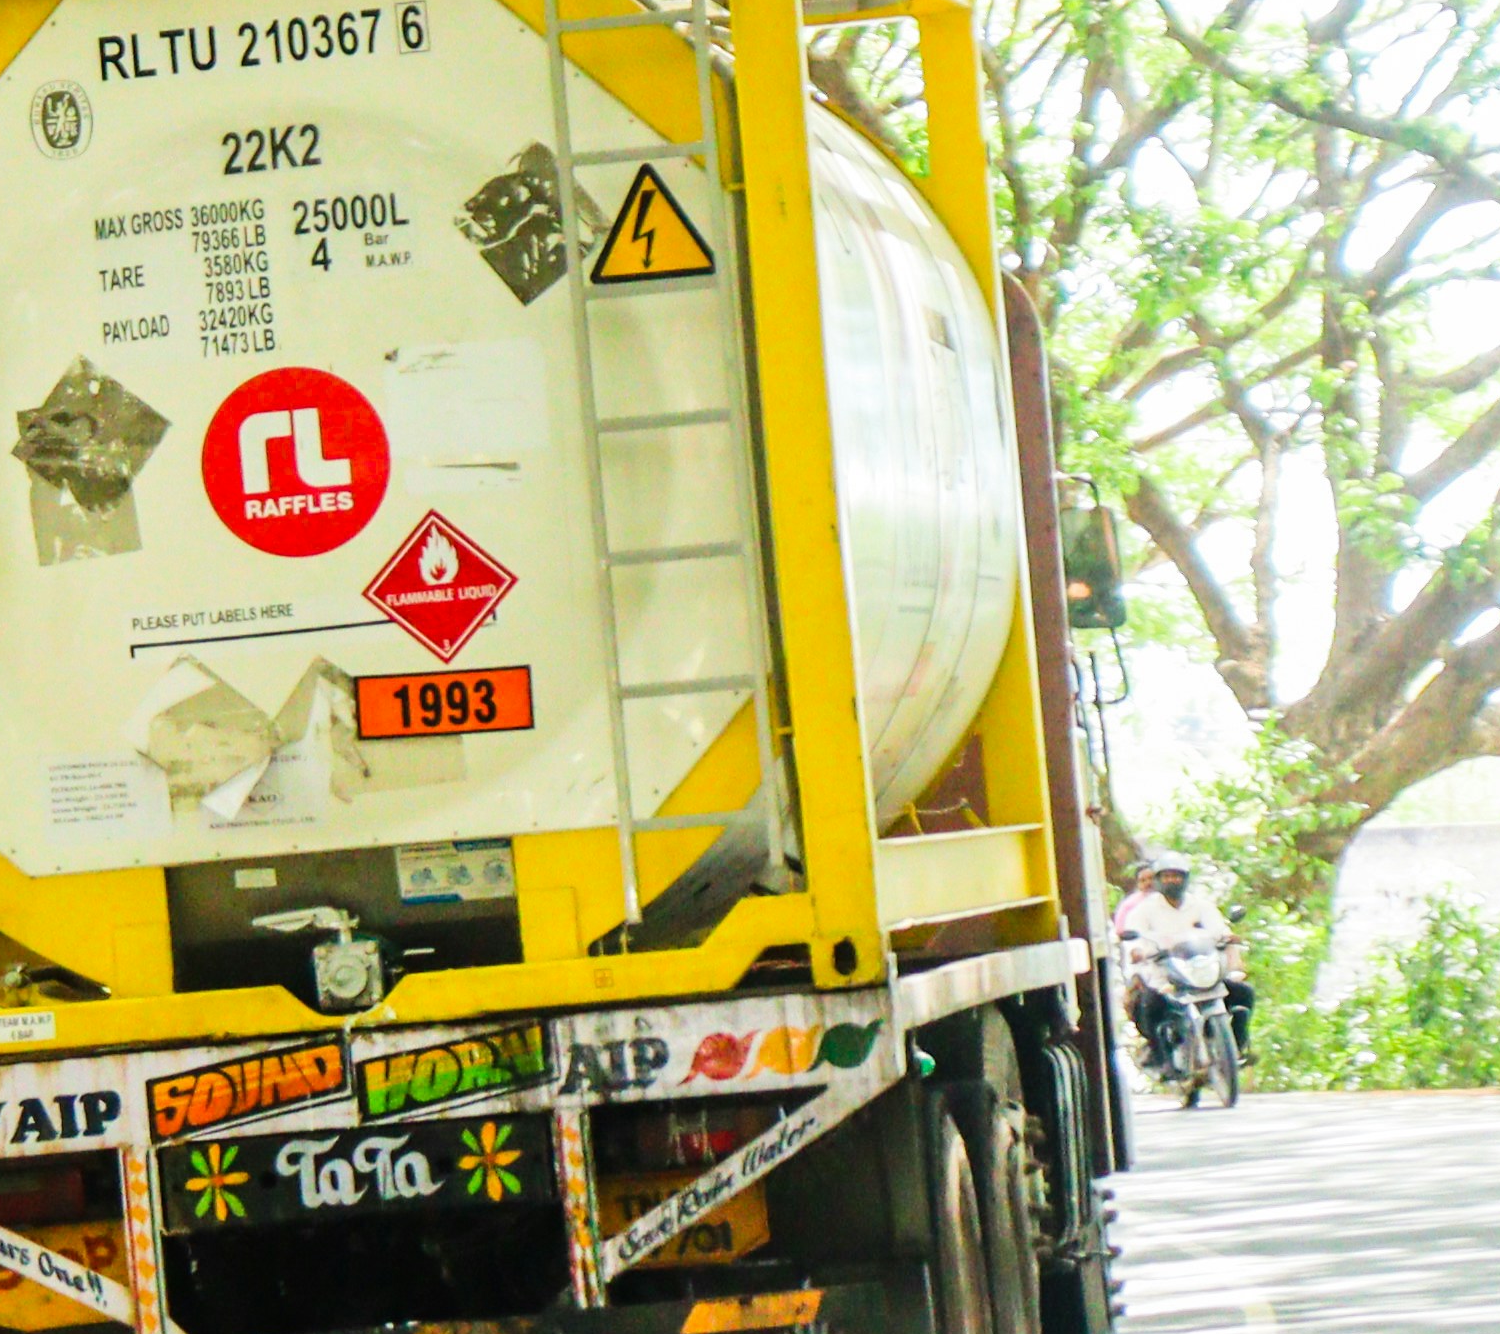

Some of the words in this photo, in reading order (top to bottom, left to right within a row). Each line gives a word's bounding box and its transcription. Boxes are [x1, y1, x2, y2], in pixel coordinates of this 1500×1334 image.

[98, 25, 217, 81] RLTU
[238, 8, 381, 67] 210367
[401, 5, 424, 49] 6
[221, 123, 322, 175] 22K2
[95, 216, 127, 241] MAX
[131, 208, 184, 235] GROSS
[190, 198, 265, 227] 36000KG
[292, 192, 410, 236] 25000L
[191, 227, 240, 253] 79366
[244, 224, 267, 248] LB
[311, 237, 332, 271] 4
[364, 231, 389, 247] Bar
[99, 264, 146, 292] TARE
[204, 250, 269, 278] 3580KG
[205, 279, 245, 304] 7893
[249, 275, 271, 300] LB
[103, 314, 170, 345] PAYLOAD
[199, 302, 274, 332] 32420KG
[200, 331, 249, 358] 71473
[243, 491, 354, 520] RAFFLES
[385, 588, 454, 607] FLAMMABLE
[458, 583, 498, 601] LIQUID
[132, 613, 179, 631] PLEASE
[182, 611, 206, 627] PUT
[209, 607, 257, 625] LABELS
[260, 603, 294, 619] HERE
[392, 678, 498, 729] 1993
[10, 1090, 122, 1144] AIP
[153, 1043, 344, 1137] SOUND
[361, 1023, 547, 1116] HORN
[558, 1036, 670, 1096] AIP
